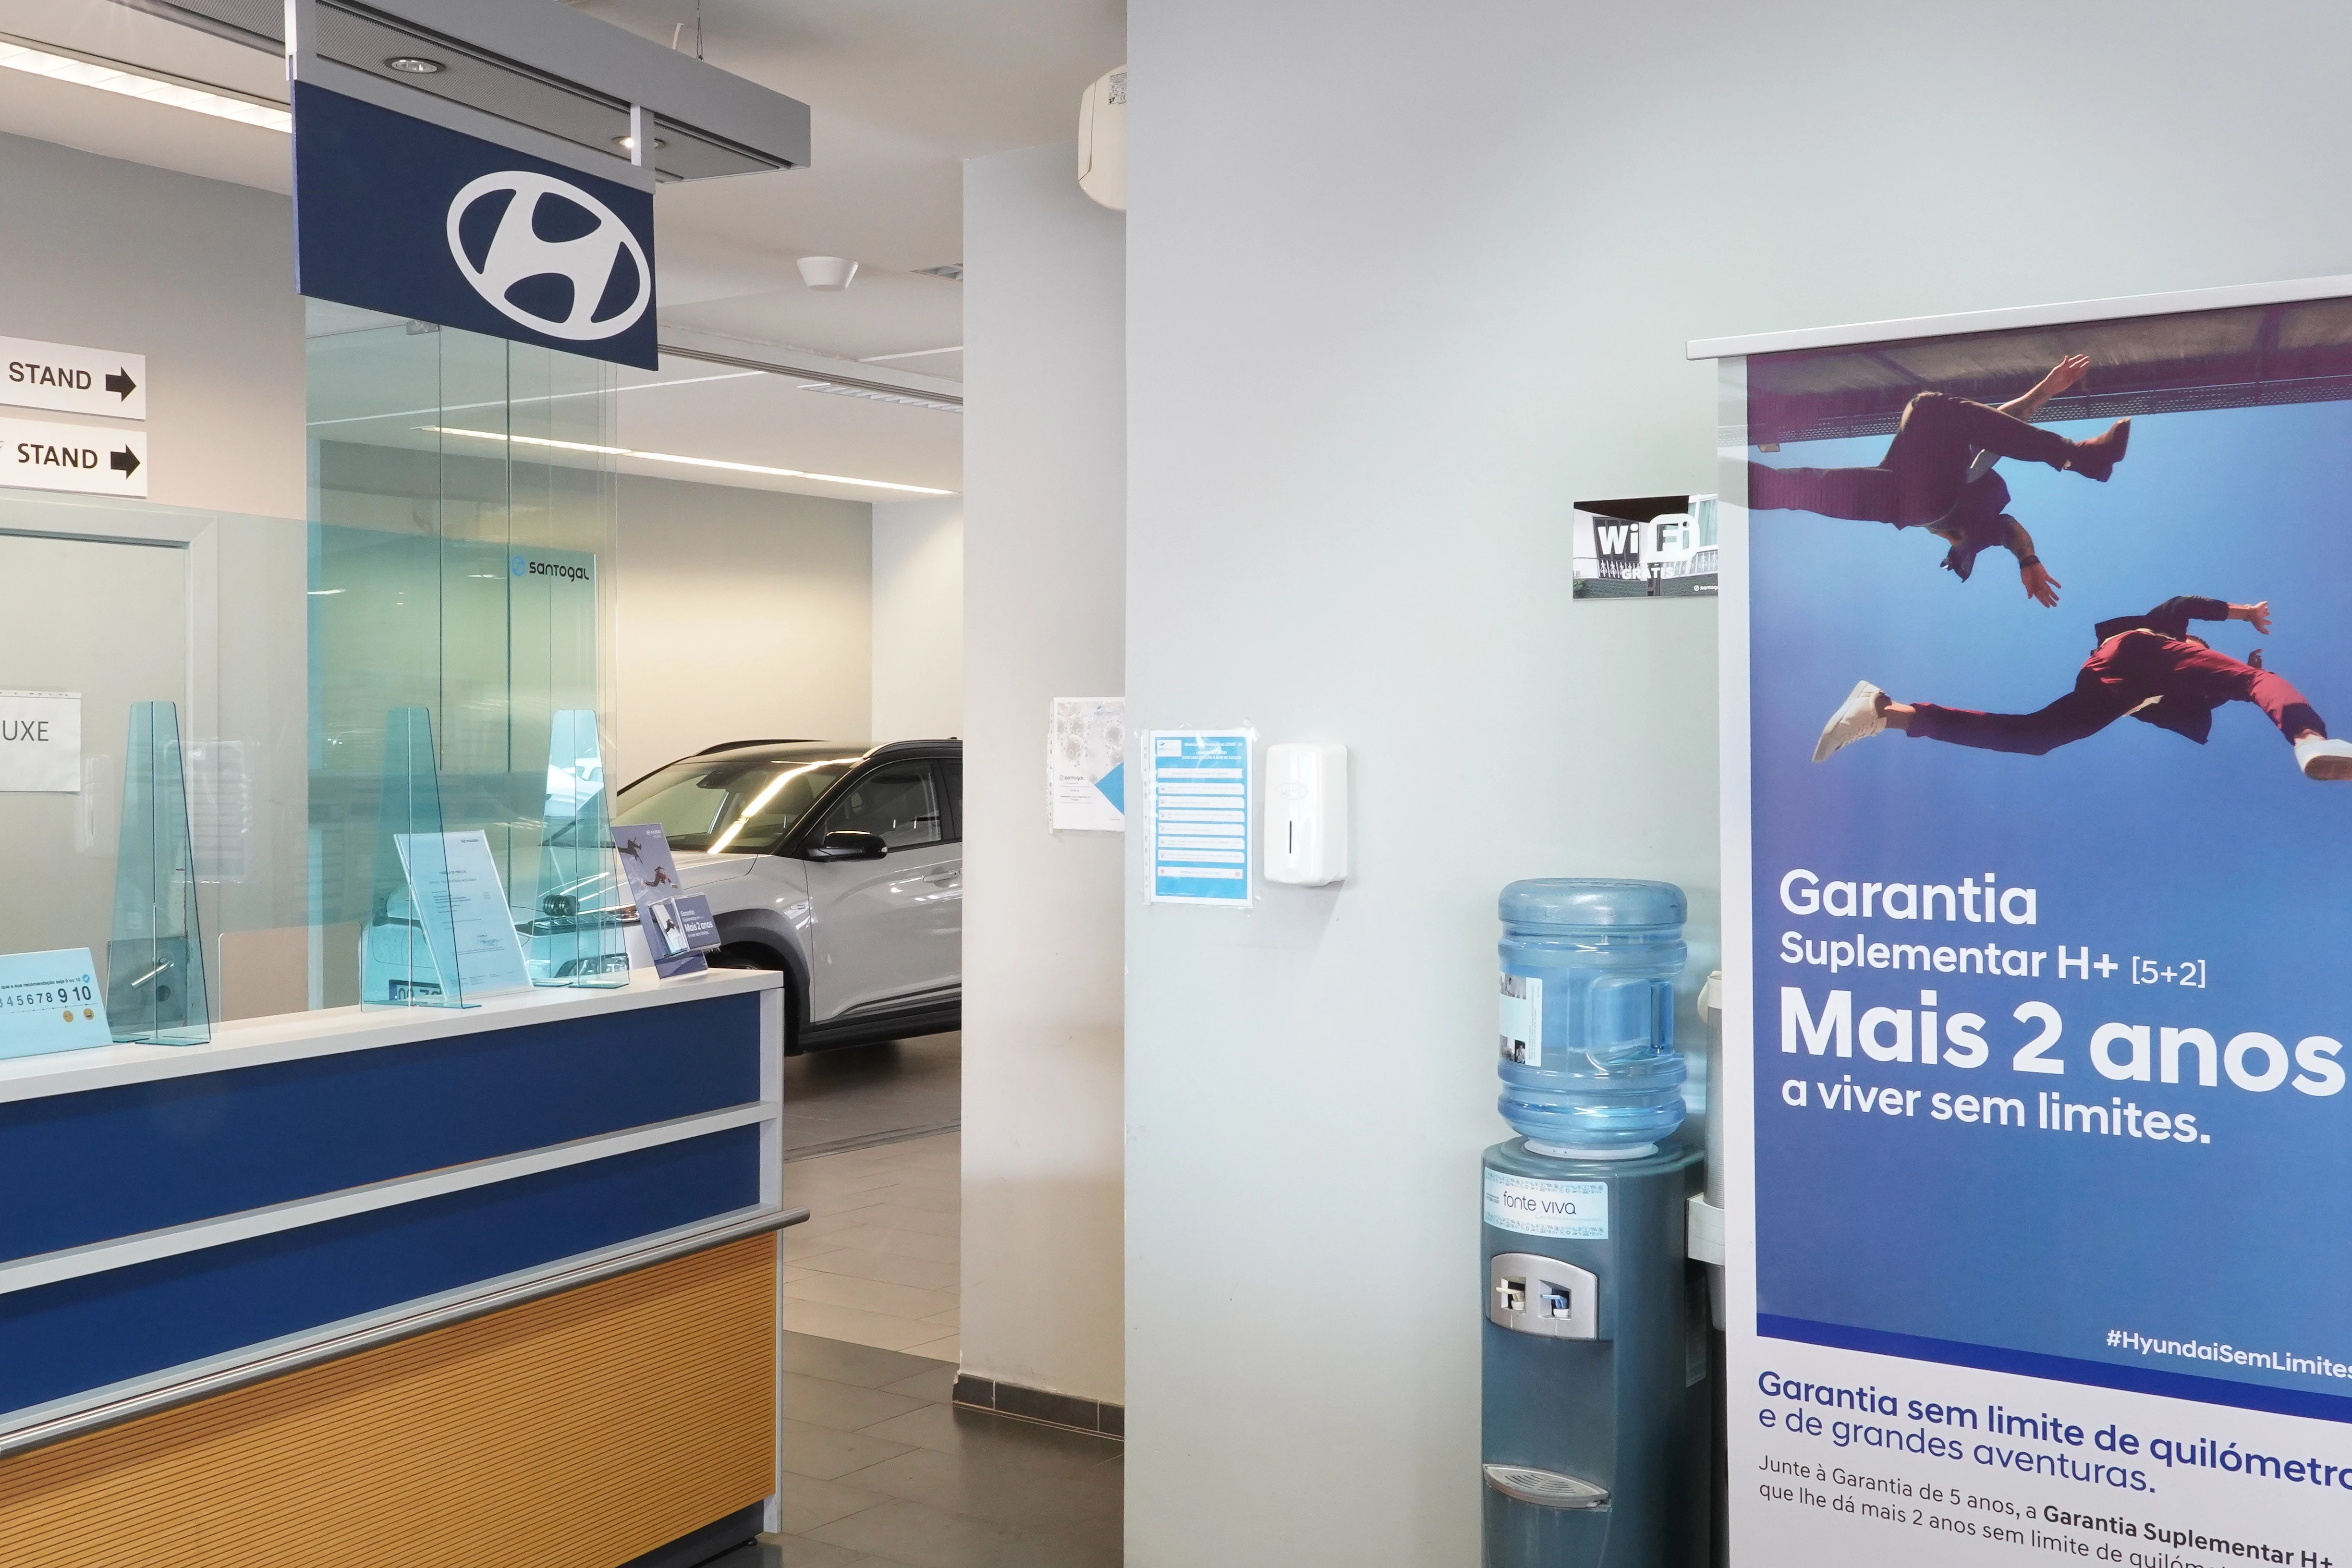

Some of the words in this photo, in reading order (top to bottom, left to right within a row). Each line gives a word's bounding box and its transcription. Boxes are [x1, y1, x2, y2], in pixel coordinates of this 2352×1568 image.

[9, 362, 91, 389] STAND
[18, 443, 98, 469] STAND
[2, 720, 49, 741] UXE
[1780, 868, 2037, 925] Garantia
[1780, 931, 2047, 976] Suplementar
[2058, 945, 2119, 980] H+
[2132, 956, 2206, 988] [5+2]
[7, 996, 13, 1007] 4
[16, 995, 24, 1006] 5
[27, 994, 34, 1004] 6
[36, 993, 43, 1003] 7
[46, 992, 53, 1002] 8
[58, 988, 68, 1003] 9
[73, 985, 91, 1001] 10
[1780, 986, 1989, 1069] Mais
[2012, 1001, 2064, 1075] 2
[2089, 1021, 2347, 1097] anos
[1781, 1079, 1807, 1106] a
[1816, 1074, 1921, 1117] viver
[1930, 1093, 2024, 1127] sem
[2039, 1092, 2210, 1143] limites.
[1503, 1191, 1536, 1211] fonte
[1541, 1201, 1577, 1215] viva
[1758, 1371, 1898, 1416] Garantia
[1907, 1398, 1977, 1429] sem
[1988, 1405, 2084, 1447] limite
[2094, 1424, 2139, 1455] de
[1759, 1408, 1776, 1427] e
[1785, 1407, 1822, 1436] de
[1832, 1420, 1963, 1460] grandes
[1974, 1443, 2156, 1493] aventuras.
[1759, 1455, 1810, 1478] Junte
[1816, 1463, 1826, 1482] à
[1832, 1468, 1912, 1497] Garantia
[1919, 1483, 1943, 1502] de
[1950, 1488, 1960, 1505] 5
[1967, 1493, 2020, 1519] anos,
[2026, 1504, 2036, 1519] a
[2044, 1505, 2137, 1537] Garantia
[2143, 1522, 2294, 1565] Suplementar
[2301, 1550, 2333, 1568] H+
[1759, 1483, 1793, 1501] que
[1799, 1487, 1826, 1508] lhe
[1832, 1494, 1854, 1513] dá
[1861, 1502, 1906, 1523] mais
[1913, 1509, 1923, 1526] 2
[1929, 1513, 1976, 1536] anos
[1983, 1525, 2023, 1545] sem
[2031, 1529, 2089, 1556] limite
[2096, 1543, 2122, 1563] de
